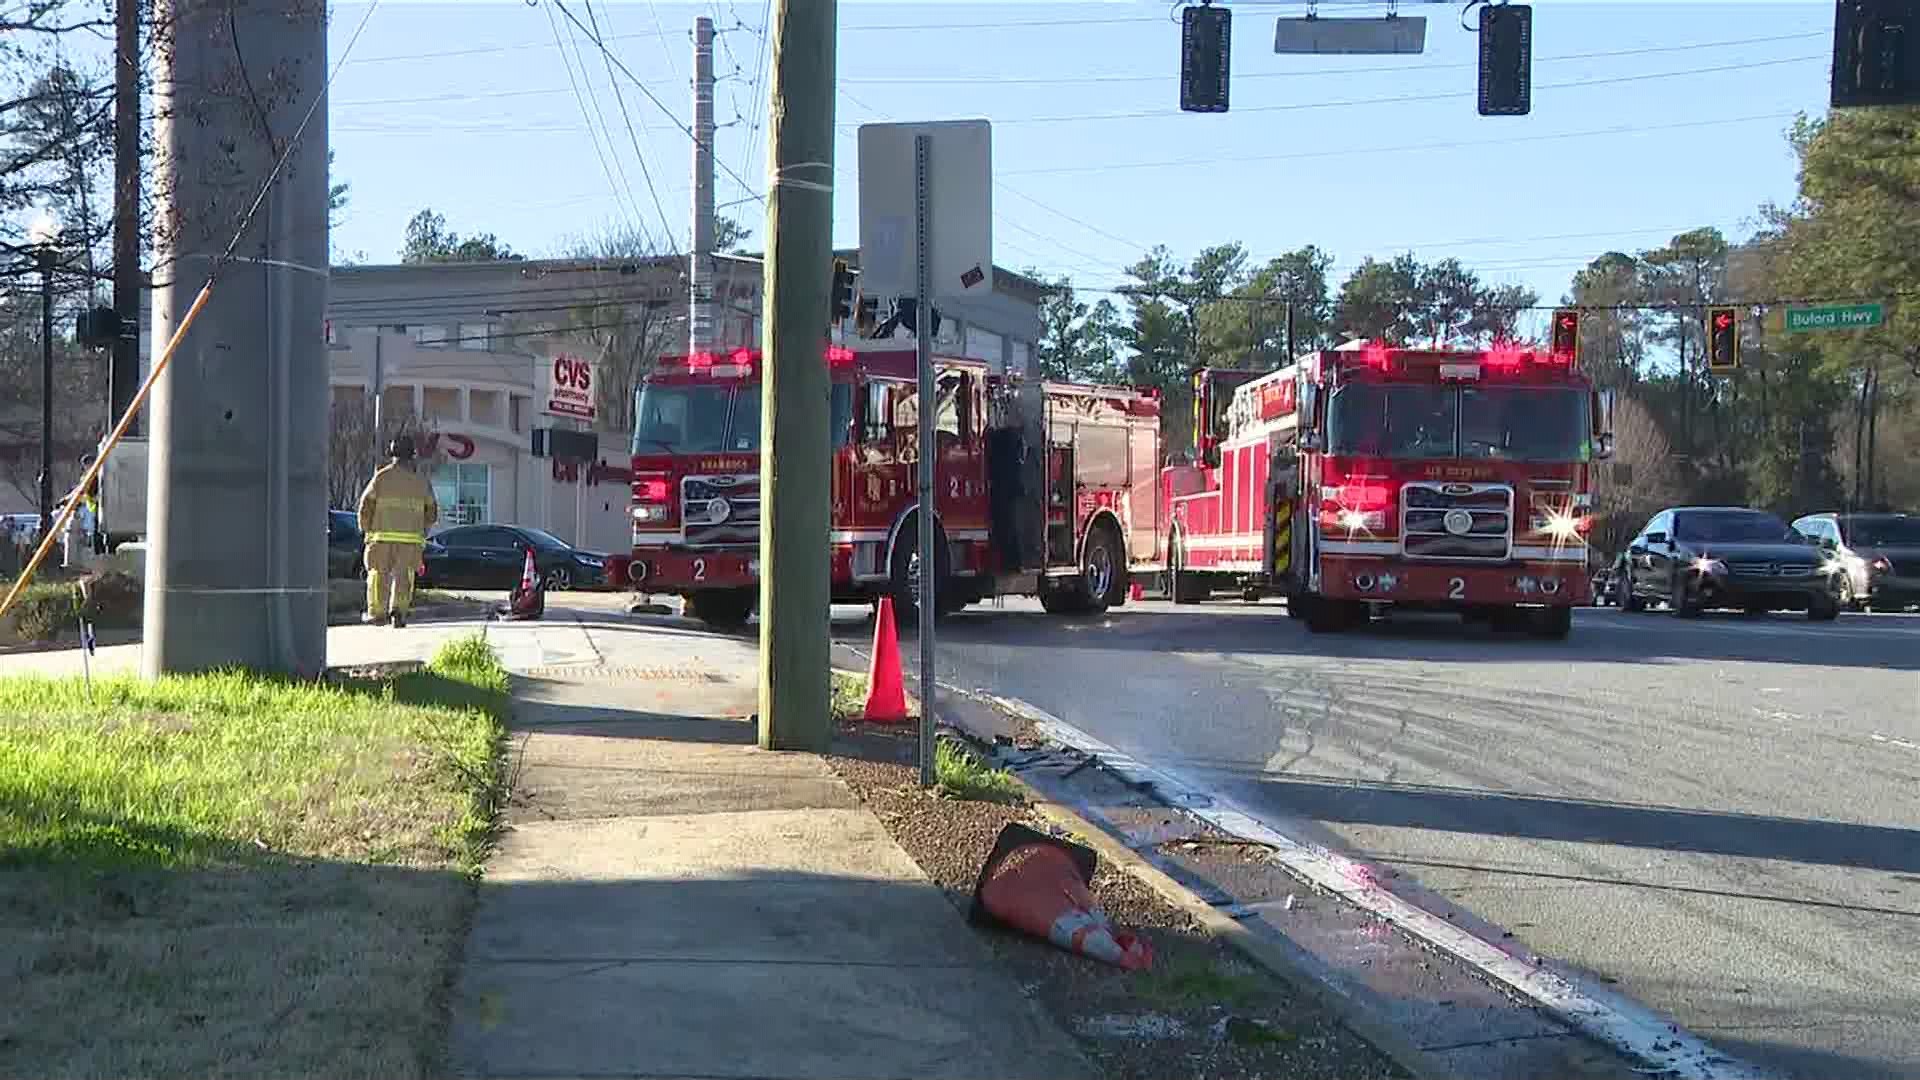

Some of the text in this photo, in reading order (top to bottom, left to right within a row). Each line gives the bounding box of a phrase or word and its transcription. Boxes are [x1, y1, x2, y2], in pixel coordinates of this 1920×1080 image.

[555, 358, 591, 390] CVS
[694, 558, 705, 580] 2
[1449, 577, 1465, 599] 2
